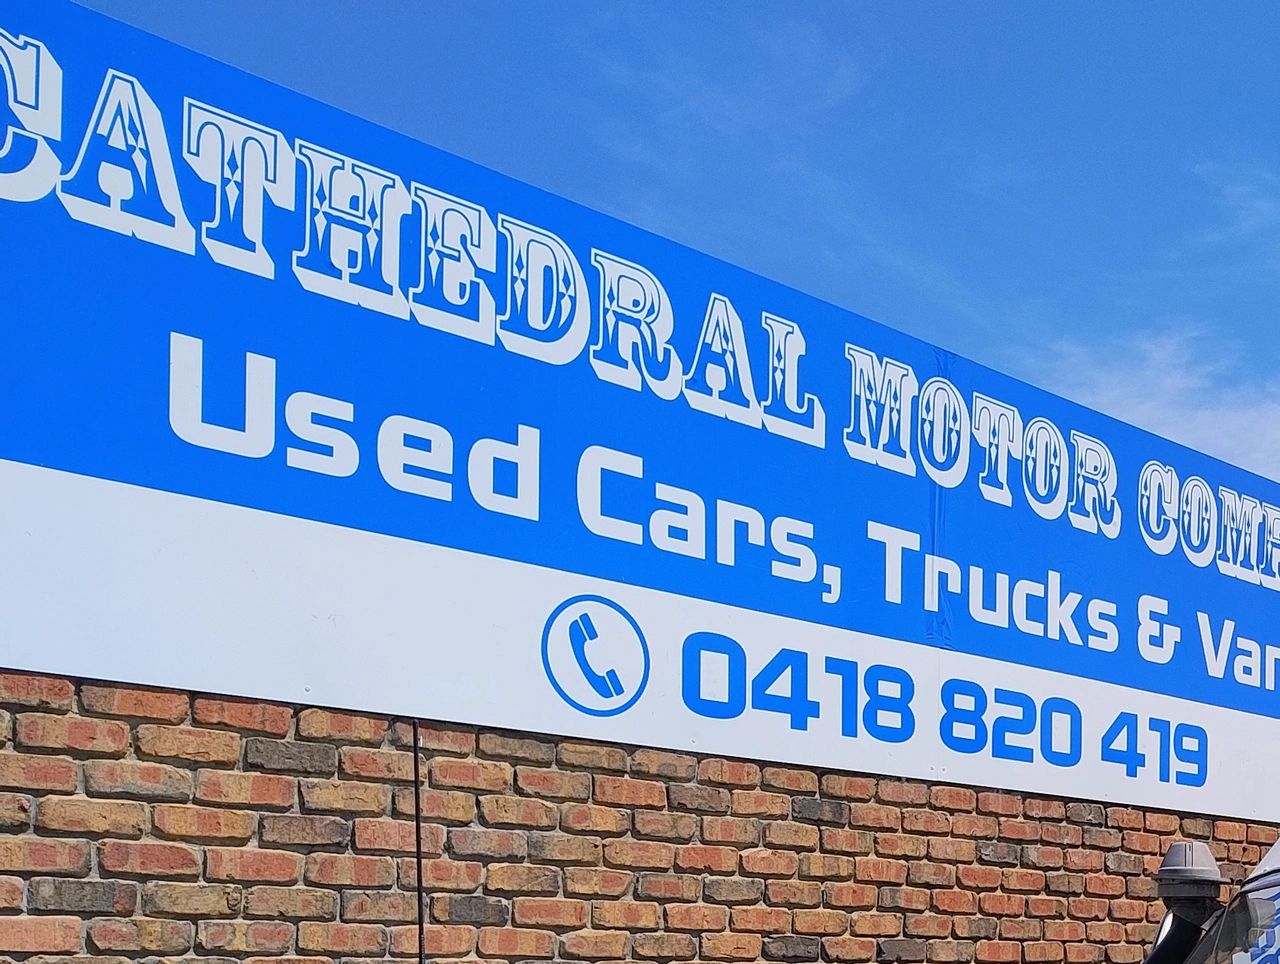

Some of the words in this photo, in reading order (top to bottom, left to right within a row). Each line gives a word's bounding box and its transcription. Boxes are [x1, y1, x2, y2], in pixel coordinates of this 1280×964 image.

[169, 331, 541, 522] Used
[576, 444, 841, 605] Cars,
[867, 520, 1120, 653] Trucks
[1137, 594, 1181, 664] &
[843, 342, 1122, 539] MOTOR
[680, 630, 917, 745] 0418
[938, 677, 1083, 768] 820
[1100, 710, 1209, 788] 419
